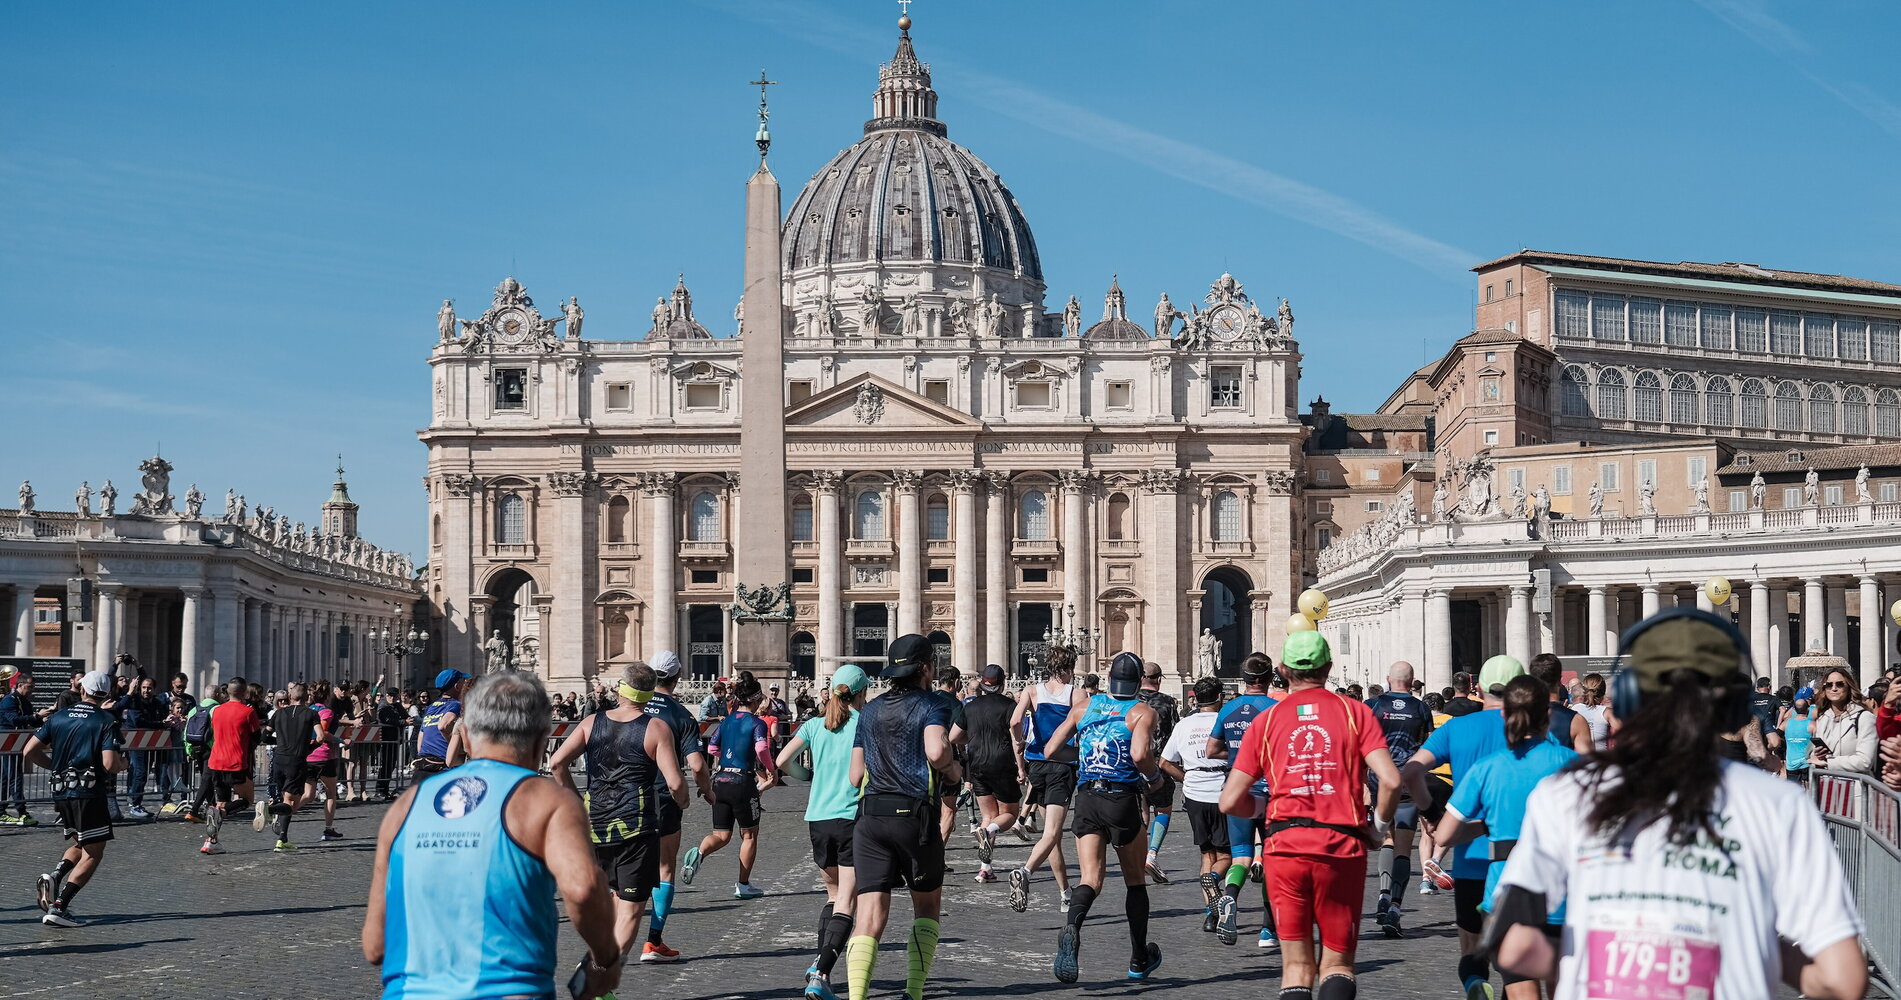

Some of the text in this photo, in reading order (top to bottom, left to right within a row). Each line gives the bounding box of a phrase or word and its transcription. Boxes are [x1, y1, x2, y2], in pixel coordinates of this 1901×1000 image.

[561, 446, 577, 455] IN
[583, 445, 652, 456] HONOREM
[723, 445, 741, 454] AP
[788, 443, 808, 453] LVS
[822, 443, 903, 453] BVRGHESIVS
[906, 442, 972, 452] ROMANVS
[1196, 749, 1206, 759] LU
[416, 839, 480, 850] AGATOCLE
[1664, 850, 1739, 881] ROMA
[1604, 940, 1692, 986] 179-B
